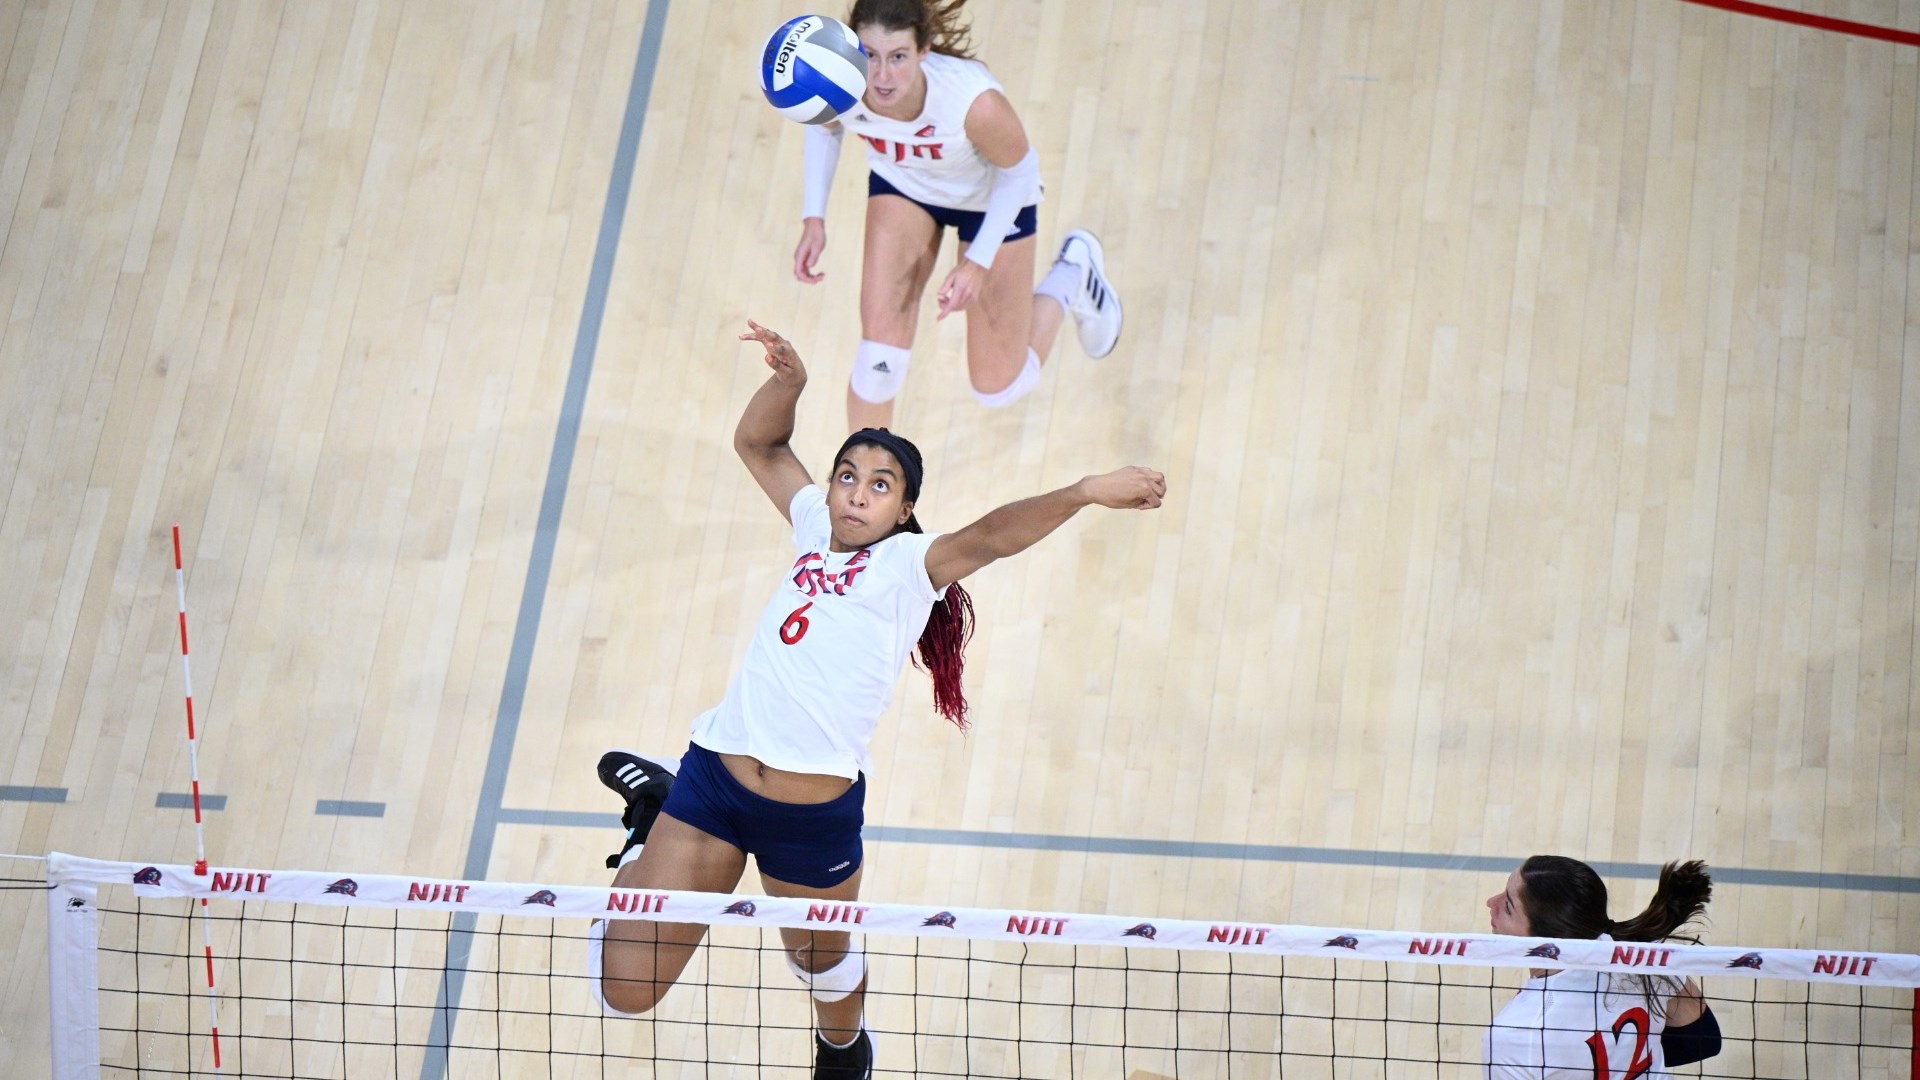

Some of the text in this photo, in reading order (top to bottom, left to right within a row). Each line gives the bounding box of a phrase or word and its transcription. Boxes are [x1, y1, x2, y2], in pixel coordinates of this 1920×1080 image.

[775, 21, 811, 74] molten
[780, 601, 813, 645] 6
[211, 872, 272, 893] NJIT
[407, 882, 470, 903] NJIT
[606, 892, 669, 913] NJIT
[806, 903, 869, 924] NJIT
[1005, 915, 1069, 936] NJIT
[1206, 925, 1270, 946] NJIT
[1408, 937, 1472, 958] NJIT
[1610, 946, 1674, 967] NJIT
[1813, 955, 1877, 976] NJIT
[1585, 1007, 1653, 1080] 12
